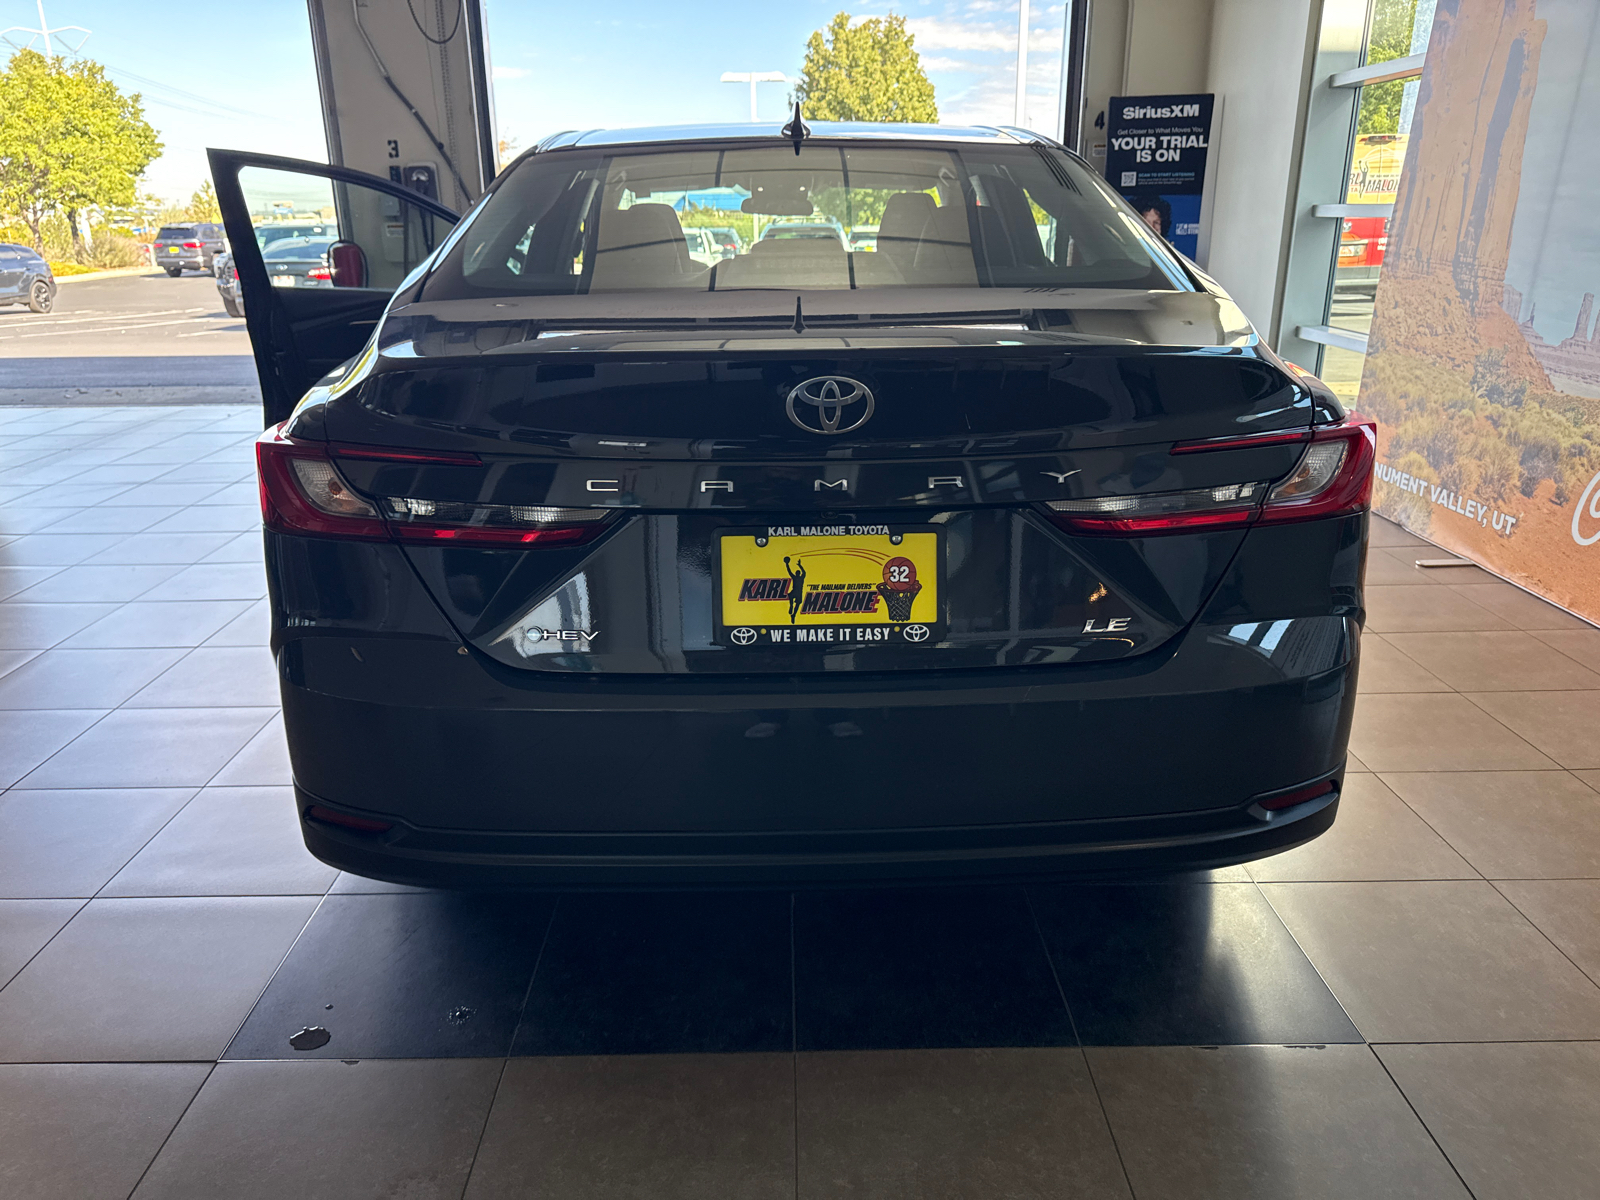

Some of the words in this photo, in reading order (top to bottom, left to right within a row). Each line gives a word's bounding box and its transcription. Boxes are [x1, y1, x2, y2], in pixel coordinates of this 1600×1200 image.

[1094, 111, 1106, 130] 4
[1122, 104, 1200, 120] SiriusXM
[1117, 128, 1128, 136] Get
[387, 139, 399, 158] 3
[1111, 136, 1157, 151] YOUR
[1159, 135, 1208, 149] TRIAL
[1136, 149, 1152, 163] IS
[1155, 149, 1180, 162] ON
[586, 468, 1083, 493] CAMRY
[1374, 461, 1428, 497] NUMENT
[1430, 484, 1488, 528] VALLEY,
[1491, 510, 1516, 535] UT
[768, 526, 798, 536] KARL
[800, 525, 846, 536] MALONE
[848, 525, 890, 535] TOYOTA
[889, 565, 910, 583] 32
[738, 578, 792, 602] KARL
[800, 591, 880, 615] MALONE
[1081, 617, 1132, 634] LE
[541, 629, 601, 641] HEV
[770, 628, 791, 642] WE
[796, 628, 834, 642] MAKE
[839, 628, 852, 641] IT
[856, 627, 890, 641] EASY
